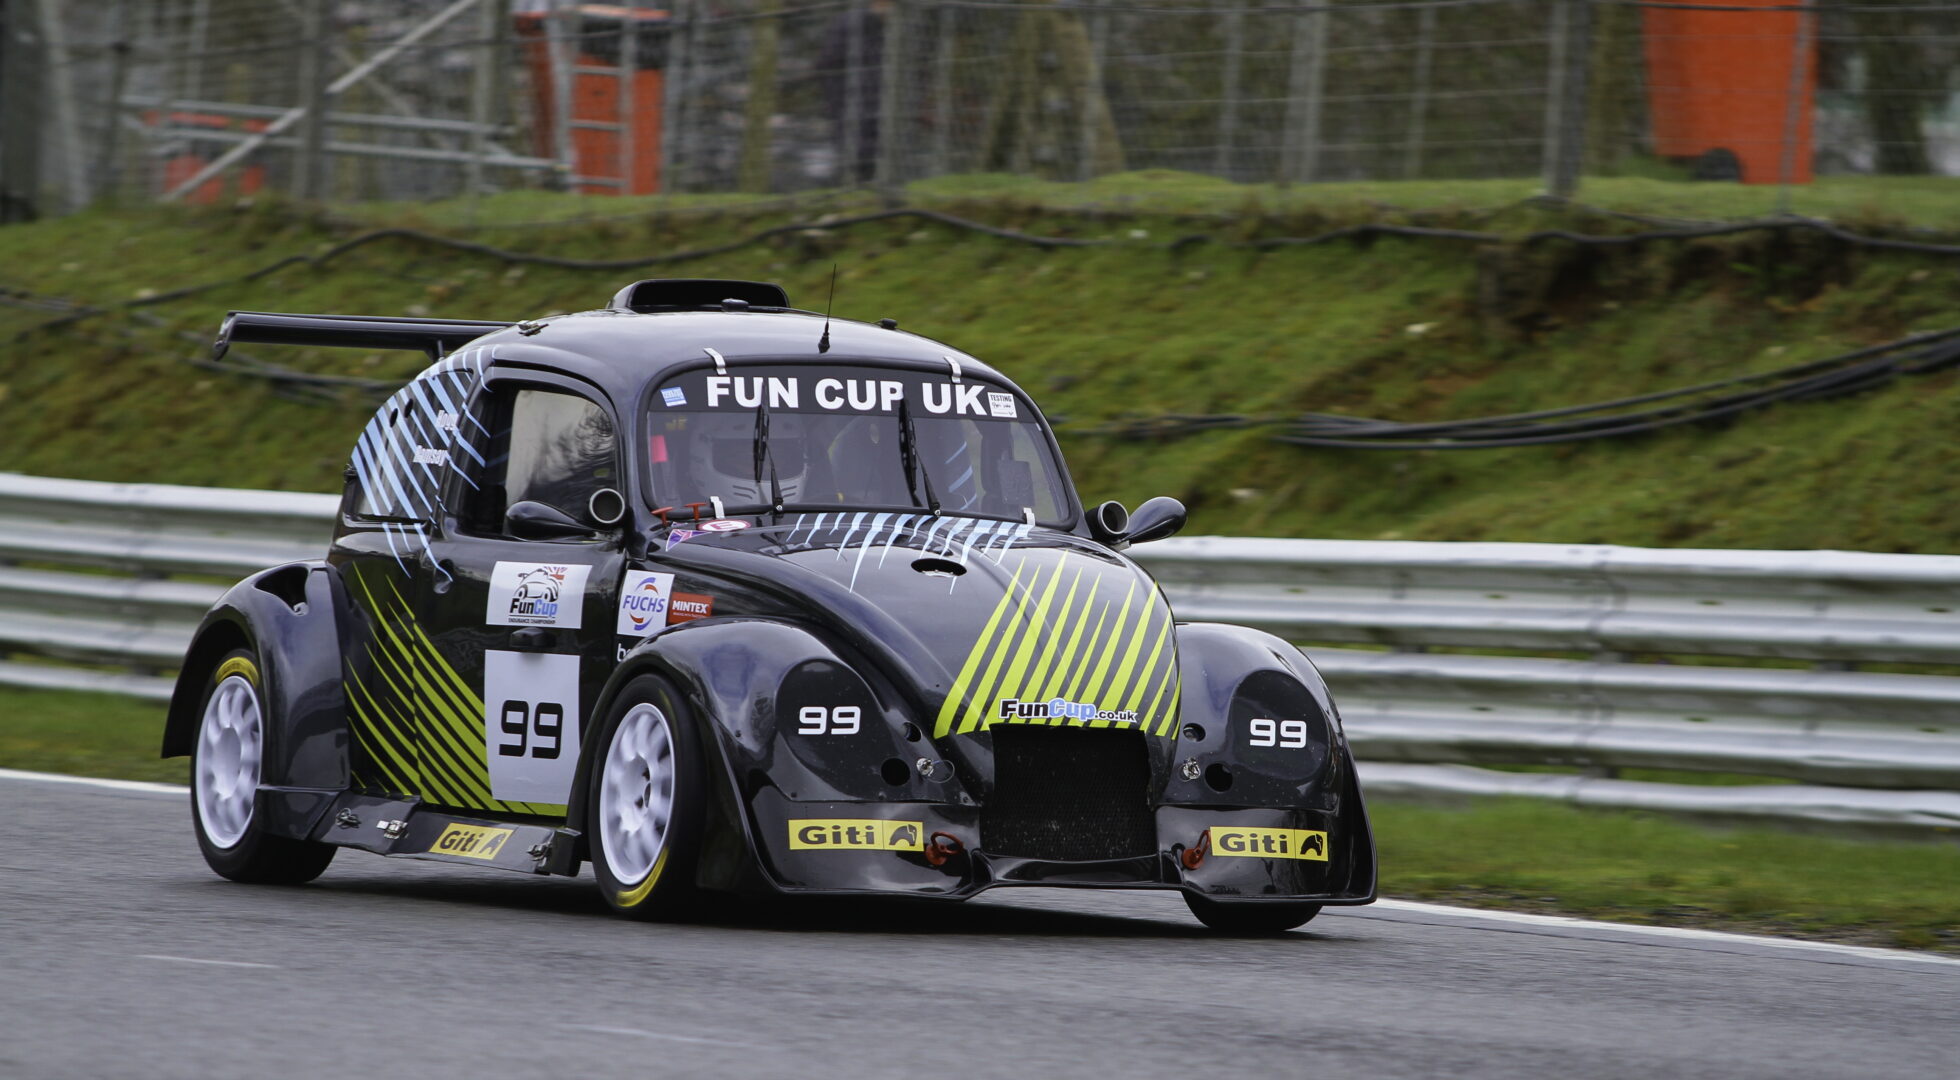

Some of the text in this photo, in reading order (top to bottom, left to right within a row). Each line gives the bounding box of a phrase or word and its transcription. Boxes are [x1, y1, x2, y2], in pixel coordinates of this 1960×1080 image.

[706, 376, 987, 415] FUN CUP UK
[990, 394, 1013, 402] TESTING
[509, 598, 558, 616] FunCup
[623, 595, 665, 613] FUCHS
[672, 600, 707, 614] MINTEX
[798, 706, 861, 735] 99
[1000, 699, 1136, 721] FunCup.co.uk
[499, 700, 563, 759] 99
[1250, 718, 1307, 749] 99
[440, 830, 484, 851] Giti
[798, 825, 875, 845] Giti
[1219, 833, 1288, 854] Giti
